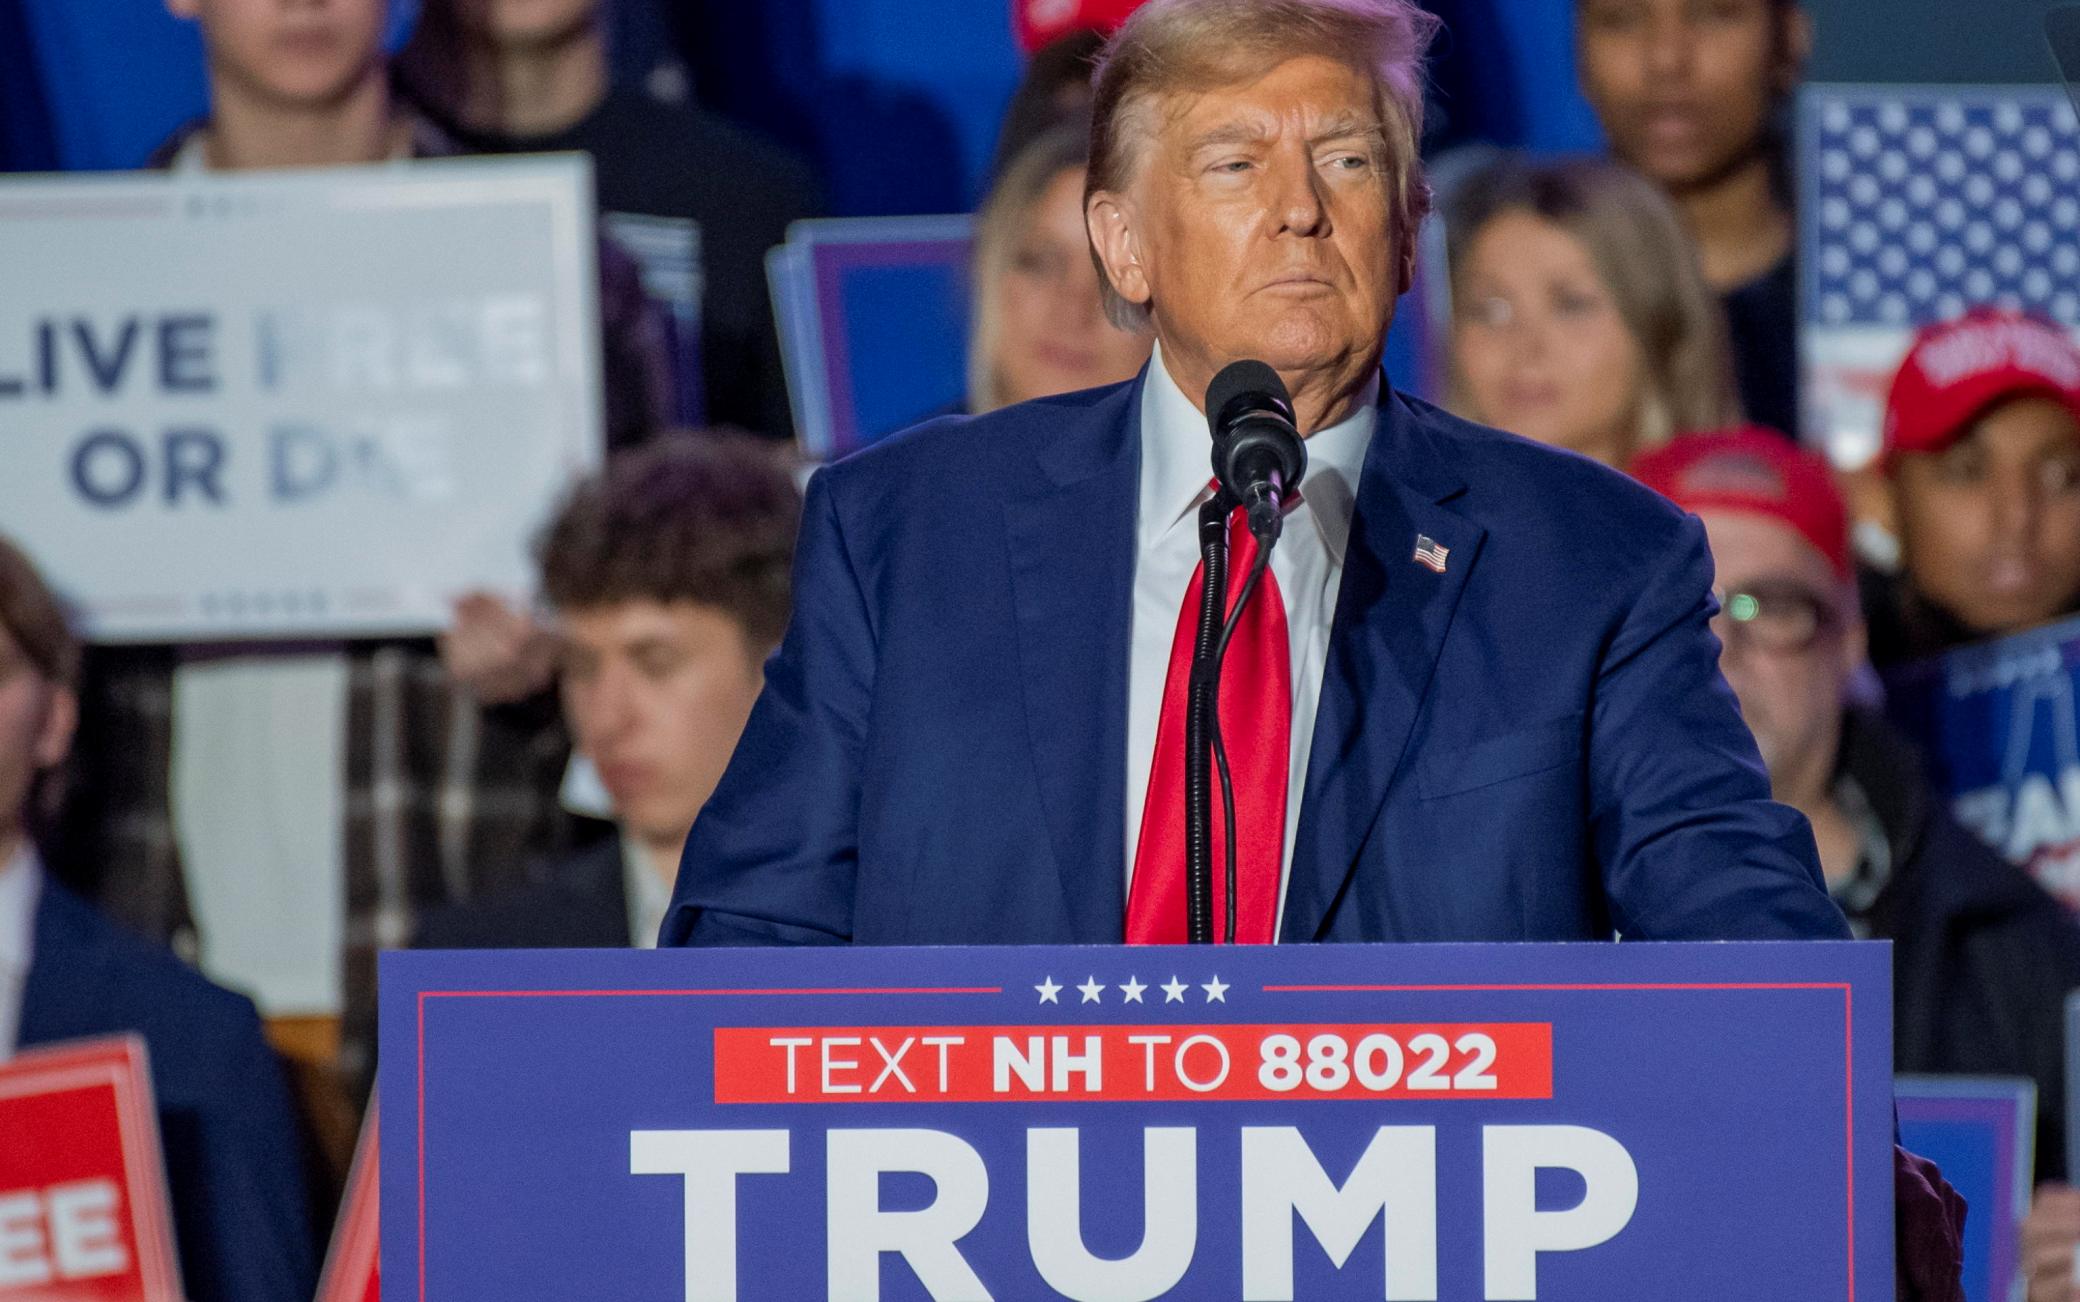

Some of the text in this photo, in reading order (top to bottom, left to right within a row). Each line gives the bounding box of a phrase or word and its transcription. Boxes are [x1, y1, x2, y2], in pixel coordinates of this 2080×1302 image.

[68, 428, 229, 511] OR
[769, 1032, 1498, 1094] TEXT NH TO 88022
[629, 1124, 1640, 1302] TRUMP
